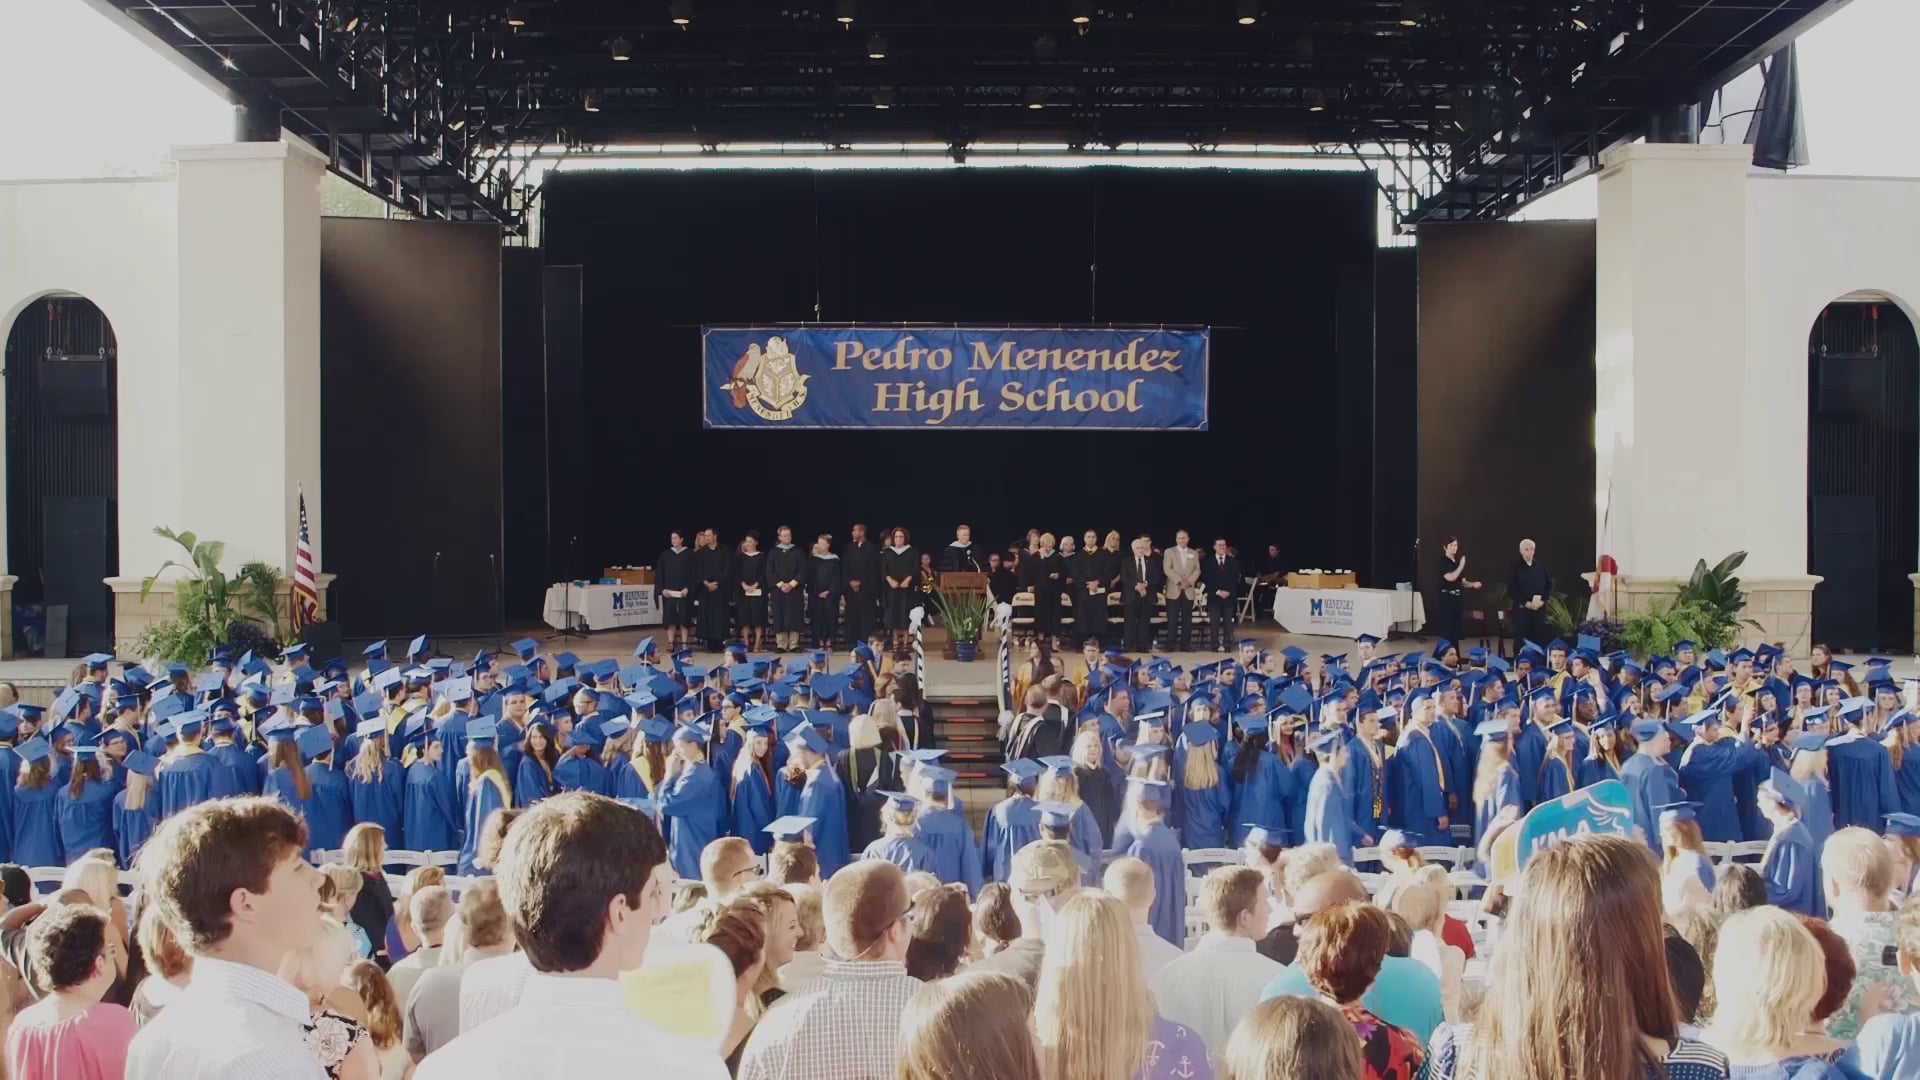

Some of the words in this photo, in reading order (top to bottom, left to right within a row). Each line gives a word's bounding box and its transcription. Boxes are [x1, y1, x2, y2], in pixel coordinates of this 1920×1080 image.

[831, 336, 952, 371] Pedro
[967, 337, 1183, 372] Menendez
[872, 378, 986, 424] High
[998, 378, 1144, 412] School
[612, 592, 624, 609] M
[1310, 598, 1323, 616] M
